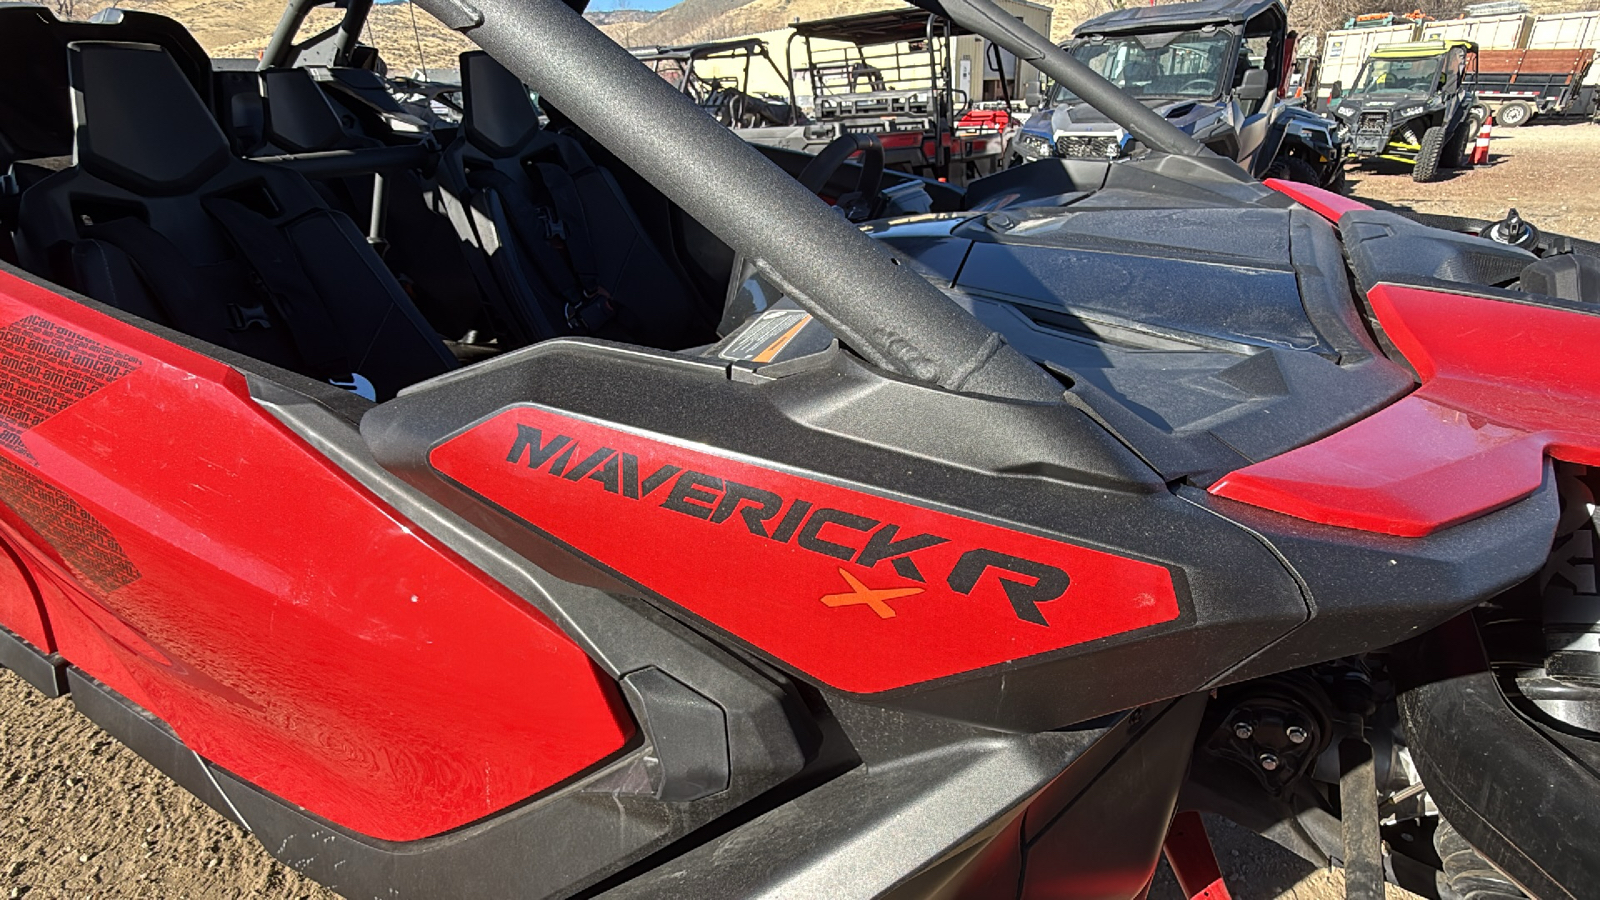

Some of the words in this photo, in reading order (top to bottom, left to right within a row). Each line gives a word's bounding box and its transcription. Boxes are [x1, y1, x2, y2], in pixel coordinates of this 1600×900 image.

[506, 424, 951, 583] MAVERICK
[947, 547, 1072, 627] R
[820, 567, 926, 620] X
